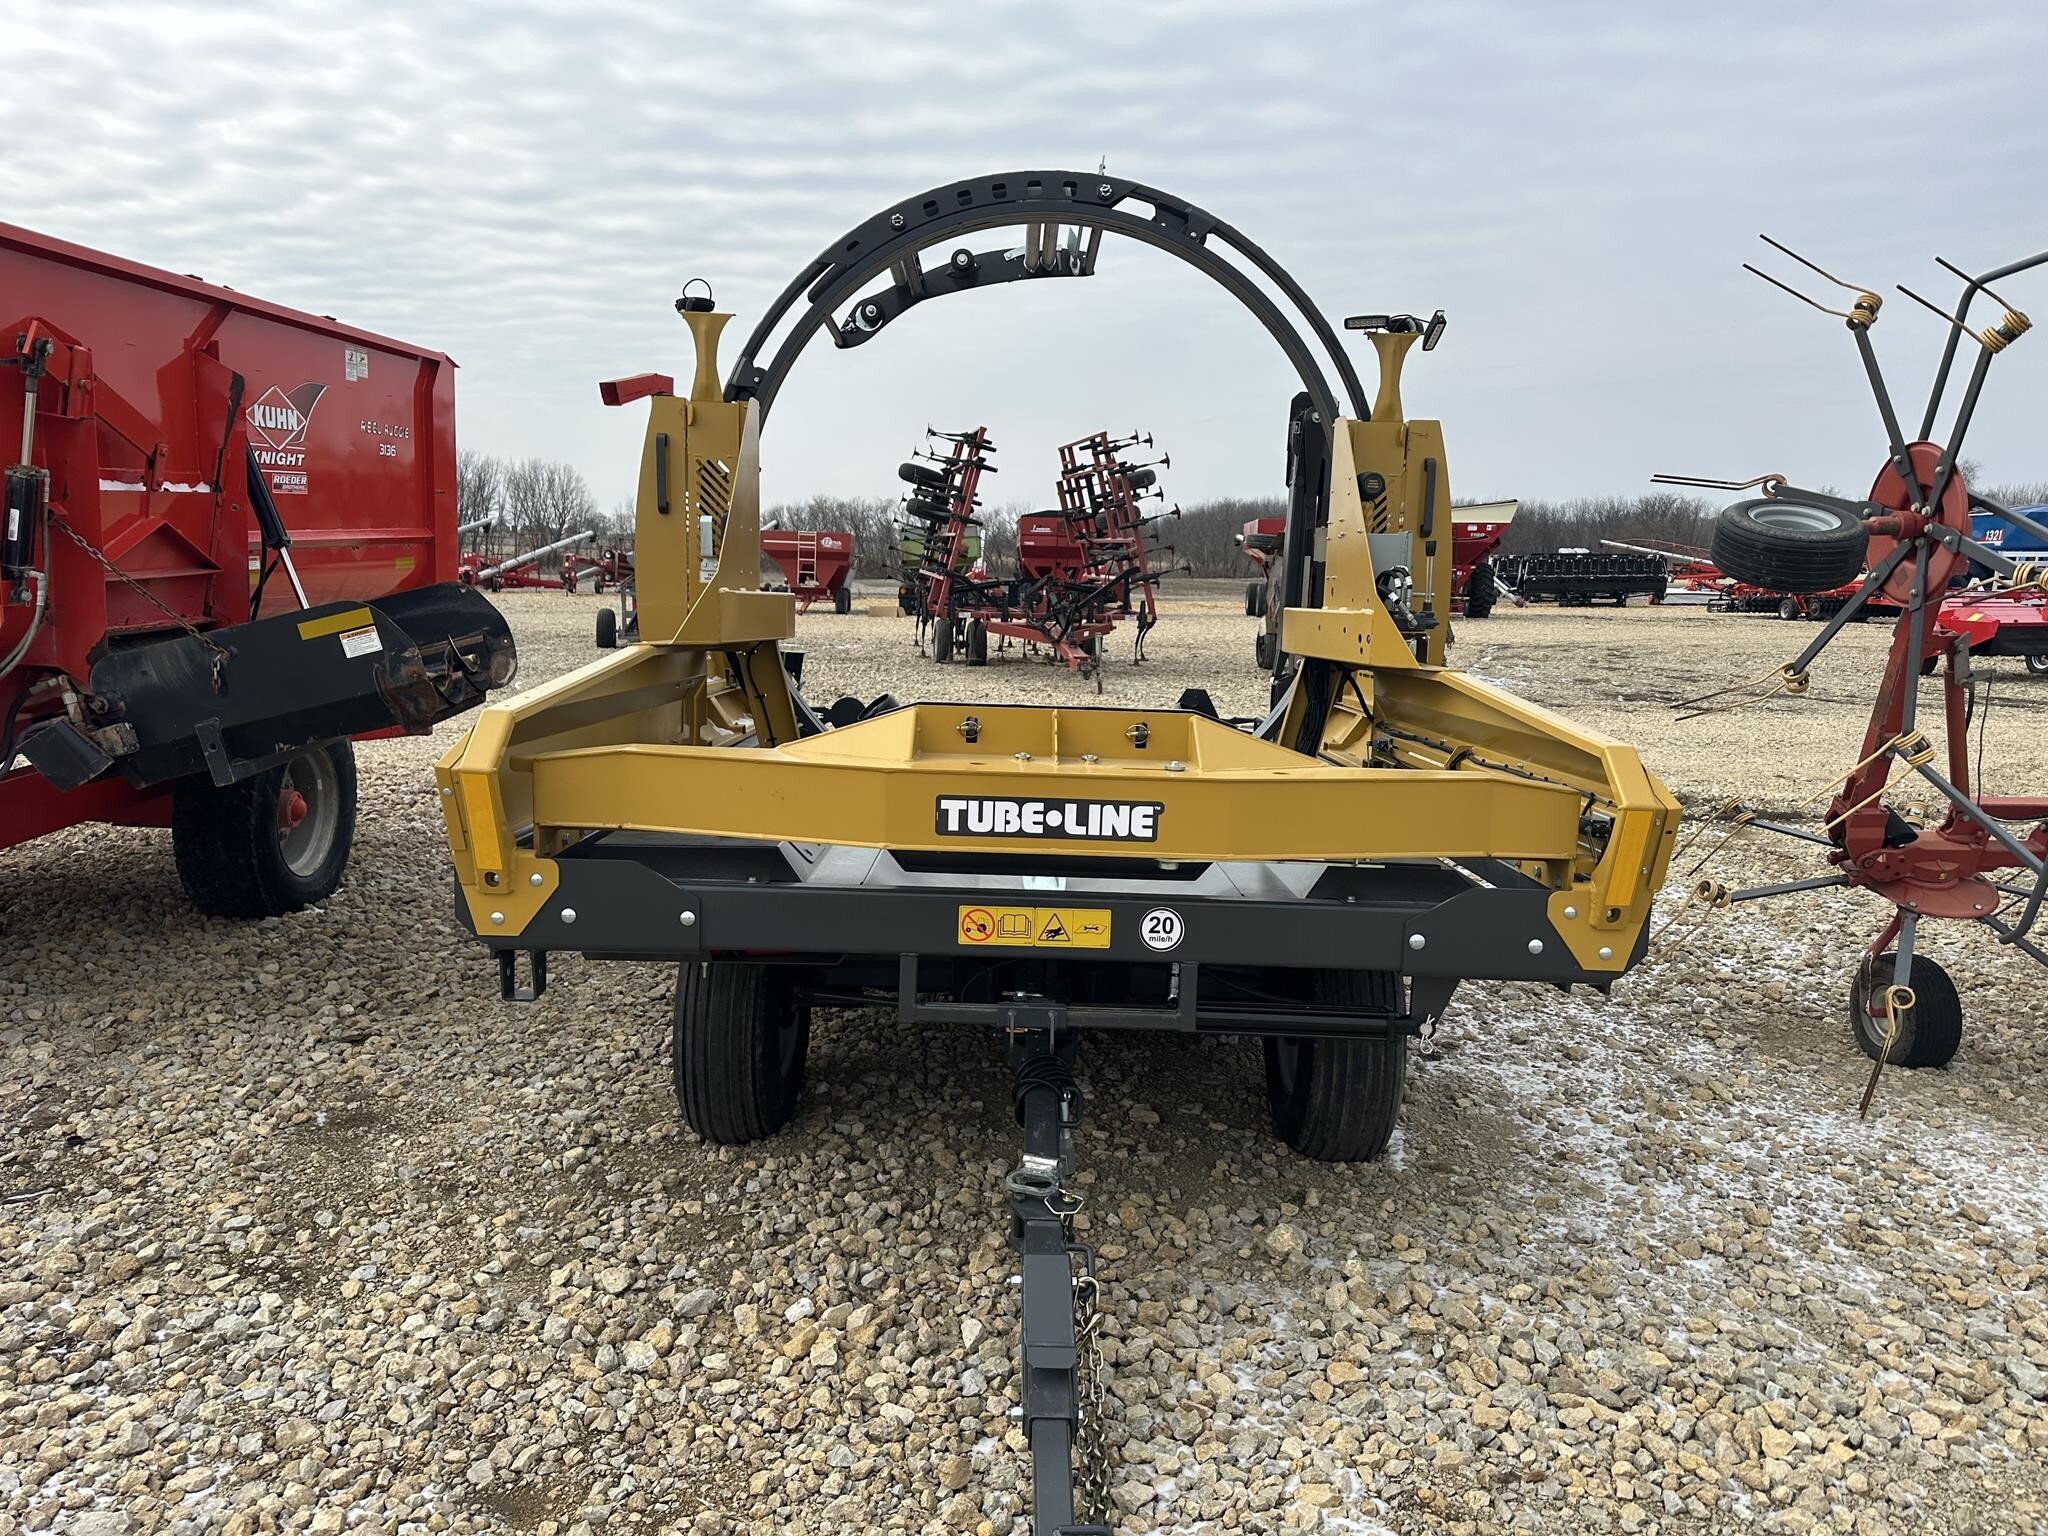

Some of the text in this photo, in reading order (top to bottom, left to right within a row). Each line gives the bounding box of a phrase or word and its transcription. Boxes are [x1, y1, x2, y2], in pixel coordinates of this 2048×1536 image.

[254, 403, 298, 431] KUHN
[360, 420, 382, 435] REEL
[379, 443, 397, 457] 3136
[273, 475, 307, 485] ROEDER
[1985, 529, 2003, 541] 1321
[1148, 916, 1174, 935] 20
